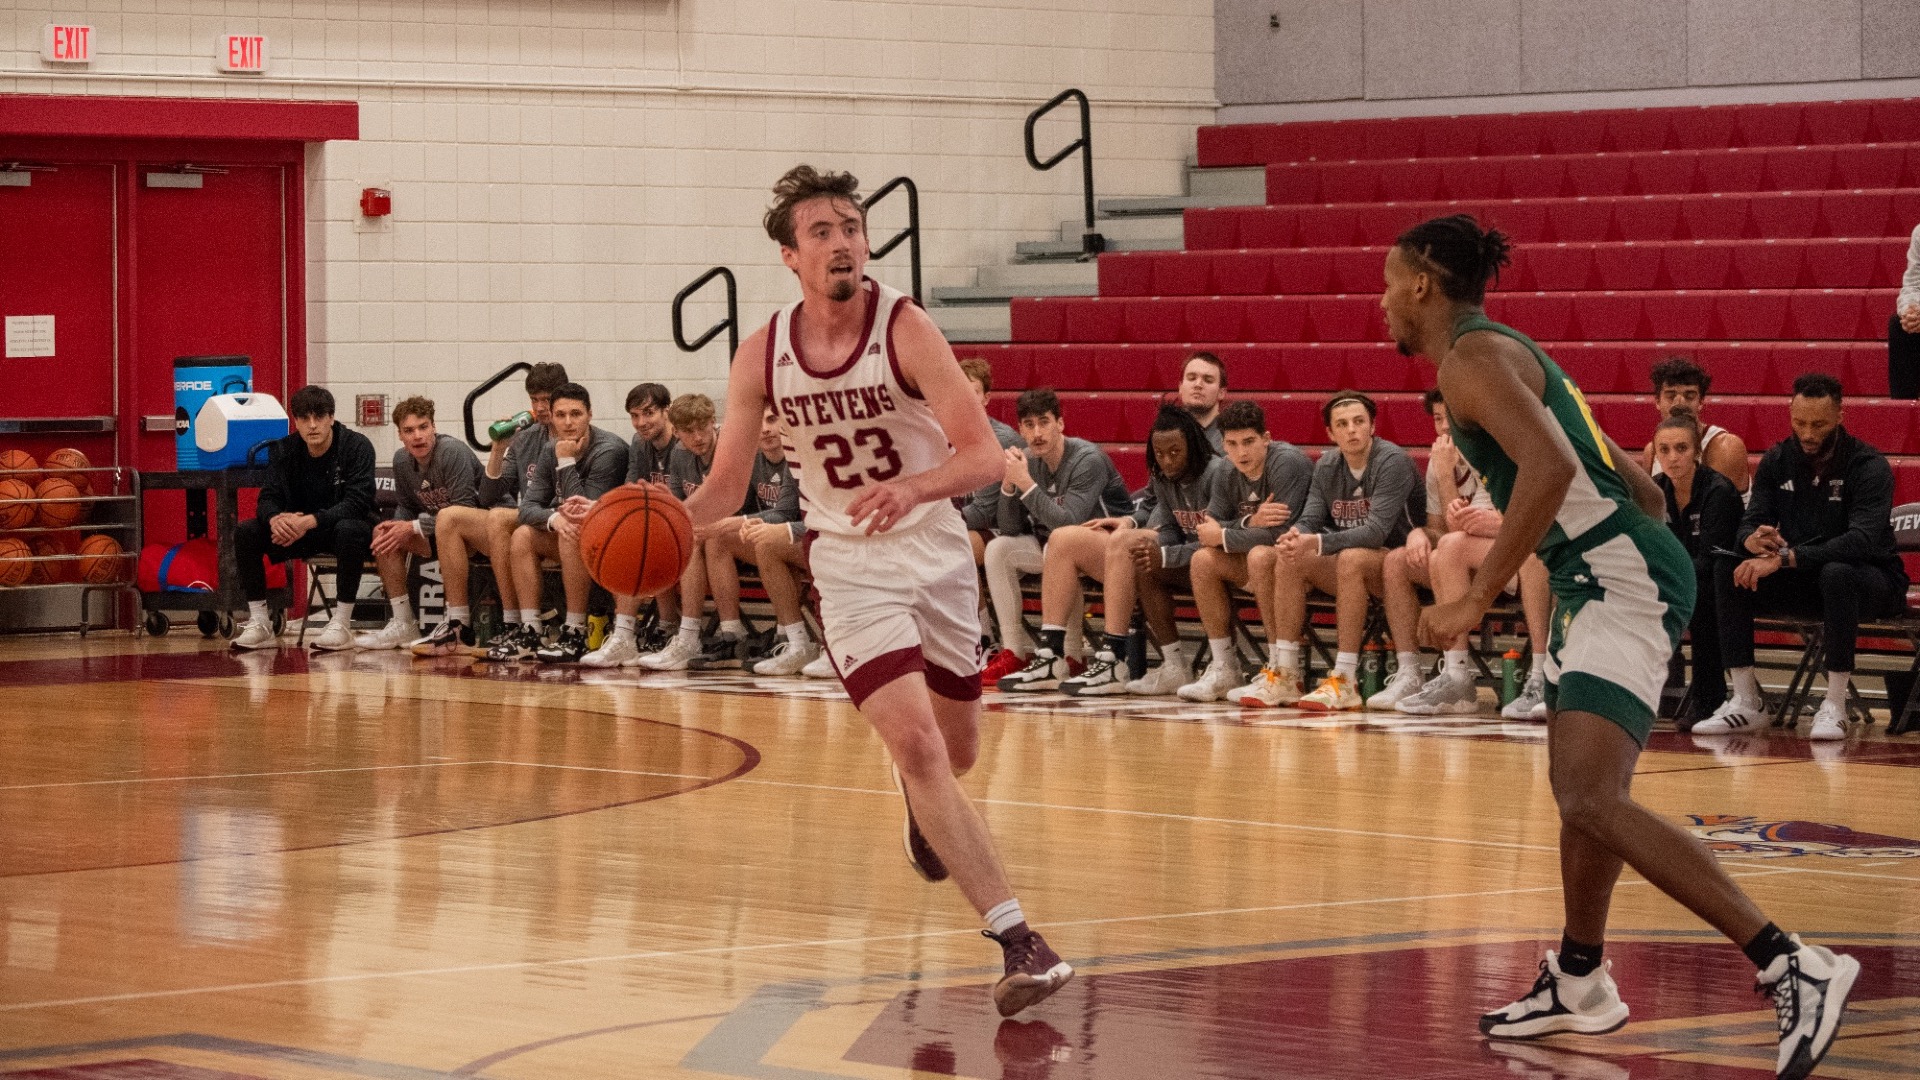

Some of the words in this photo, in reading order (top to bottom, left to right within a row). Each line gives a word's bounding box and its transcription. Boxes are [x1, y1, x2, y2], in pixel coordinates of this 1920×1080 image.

[53, 26, 90, 59] EXIT
[228, 36, 264, 69] EXIT
[780, 384, 896, 427] STEVENS
[813, 427, 903, 490] 23
[419, 560, 444, 630] TRA
